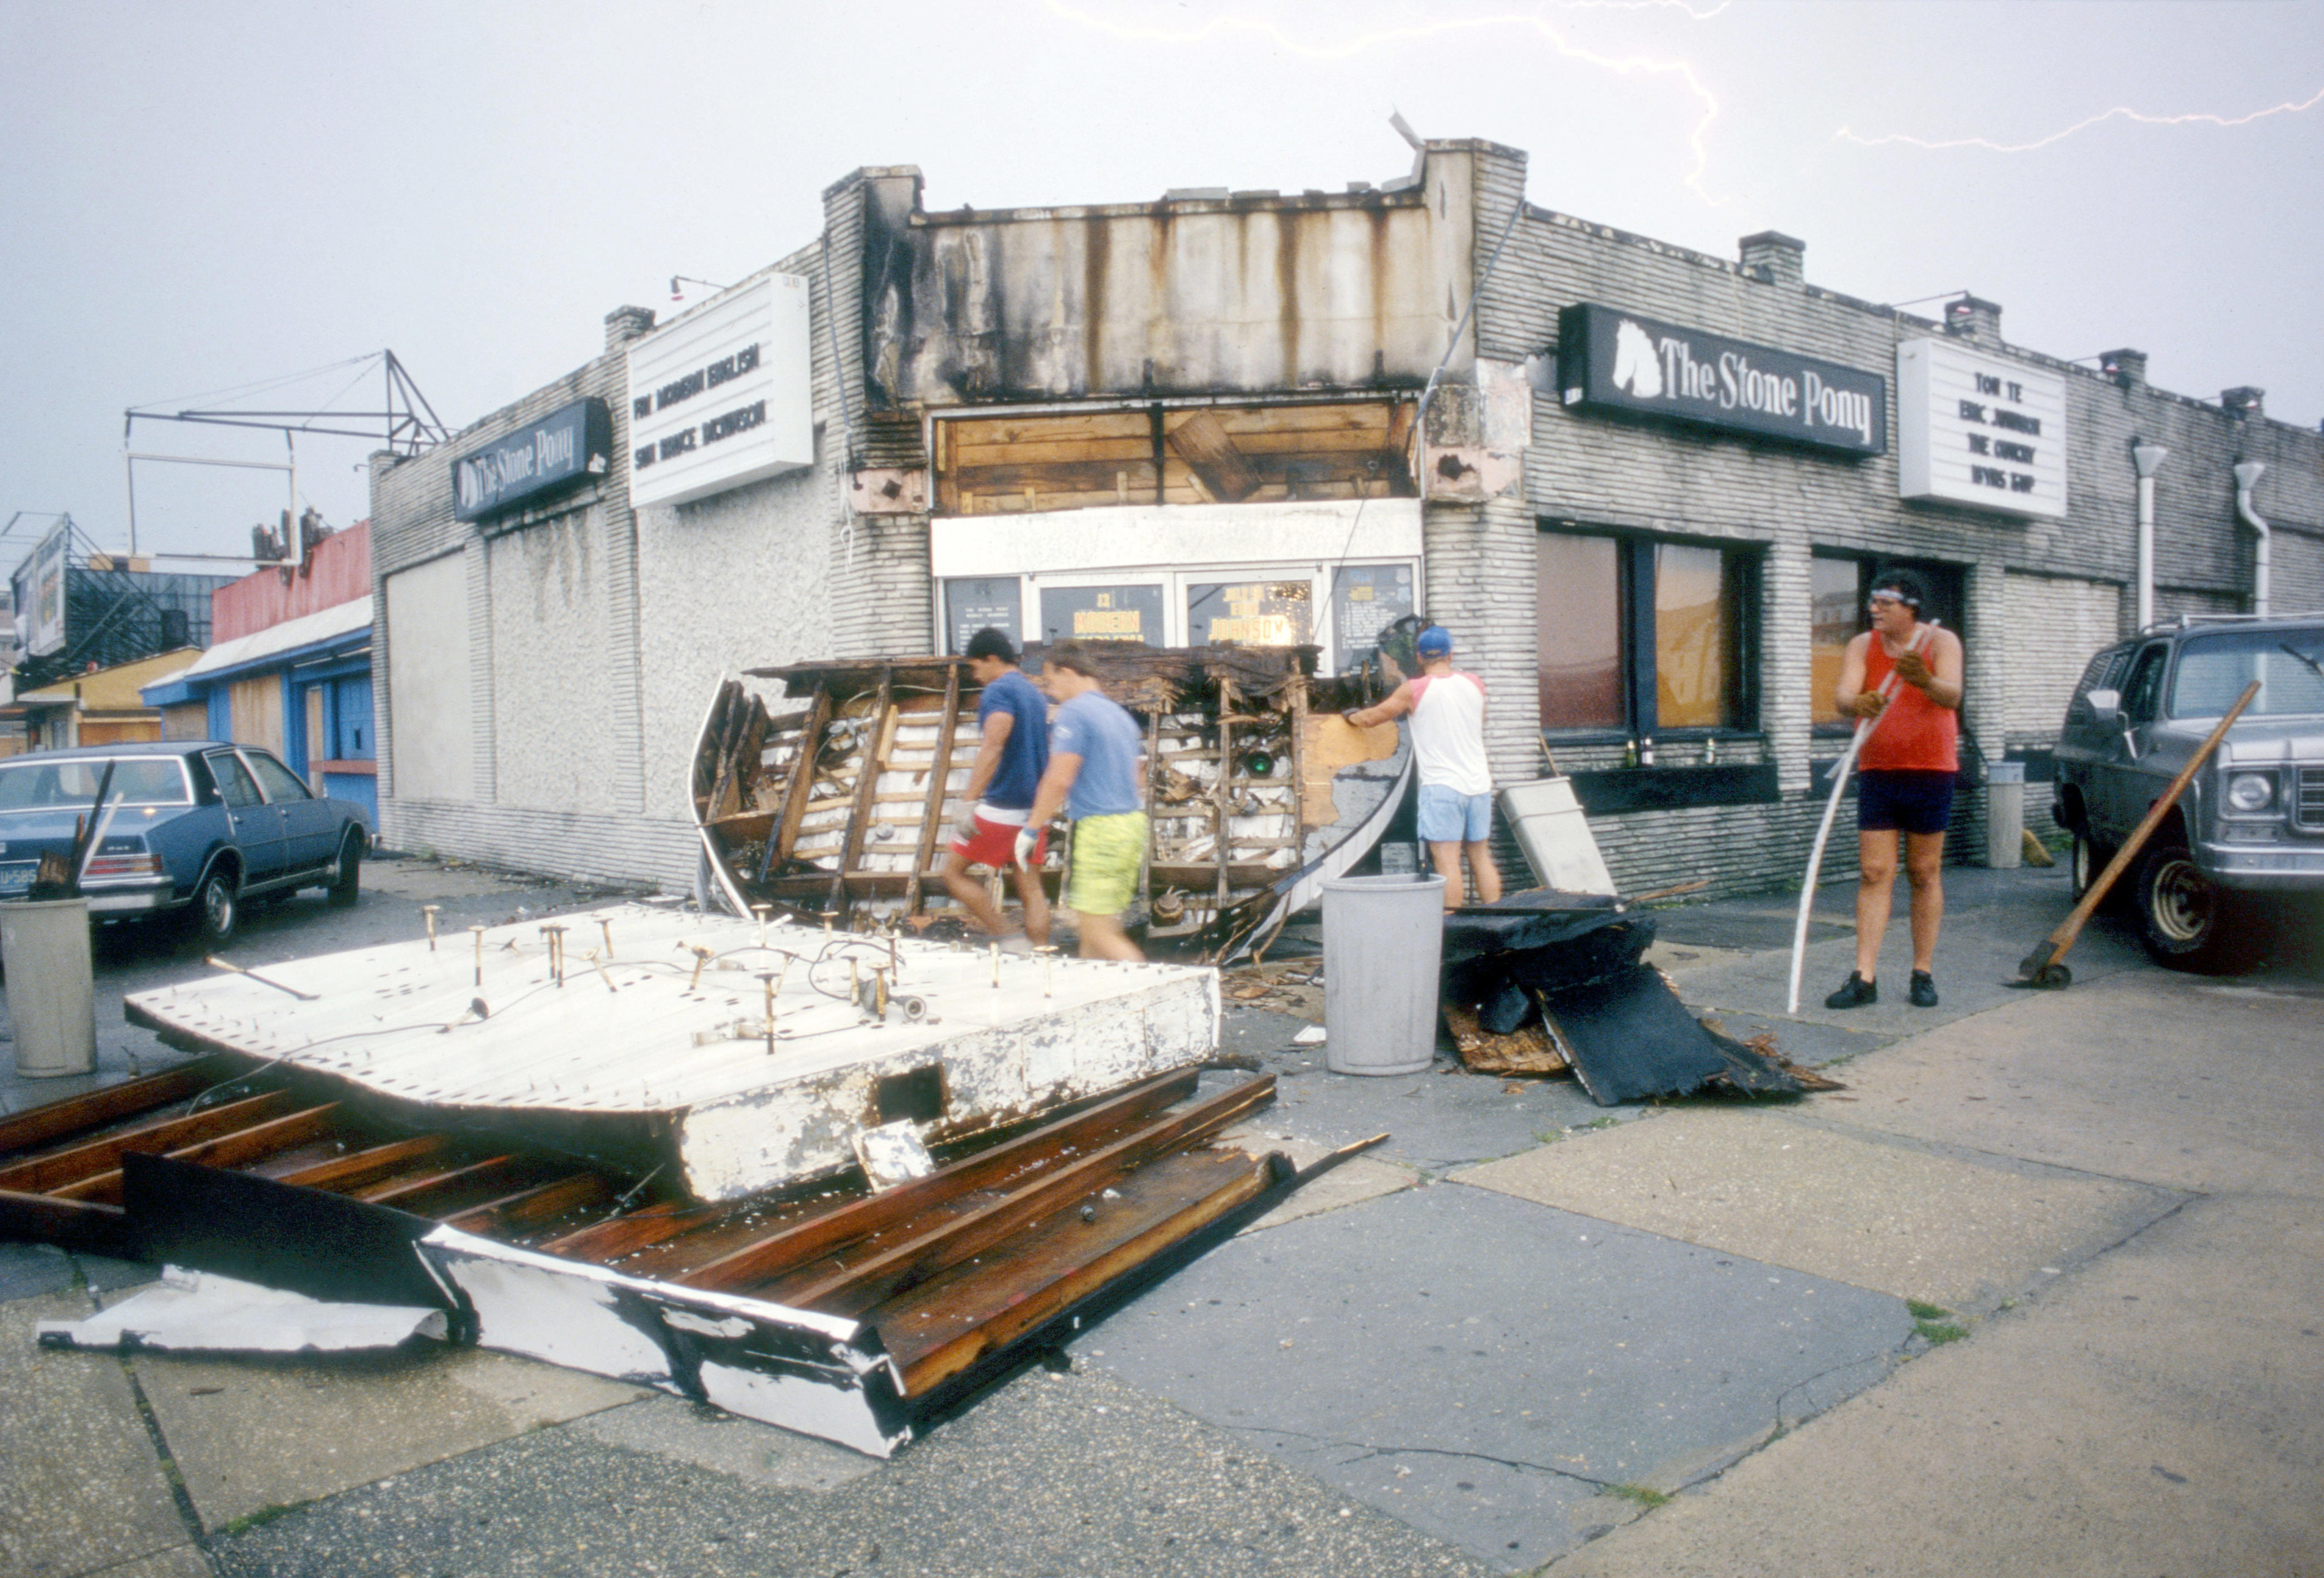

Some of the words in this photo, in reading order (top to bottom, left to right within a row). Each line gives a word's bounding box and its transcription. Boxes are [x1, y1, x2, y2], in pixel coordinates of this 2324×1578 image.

[657, 369, 705, 411] MODERN
[707, 342, 760, 389] ENGLISH
[1660, 337, 1715, 400] The
[1719, 351, 1797, 417] Stone
[1802, 370, 1871, 445] Pony
[475, 457, 497, 501] The
[497, 445, 533, 491] Stone
[536, 425, 574, 476] Pony
[1074, 611, 1140, 634] MODERN
